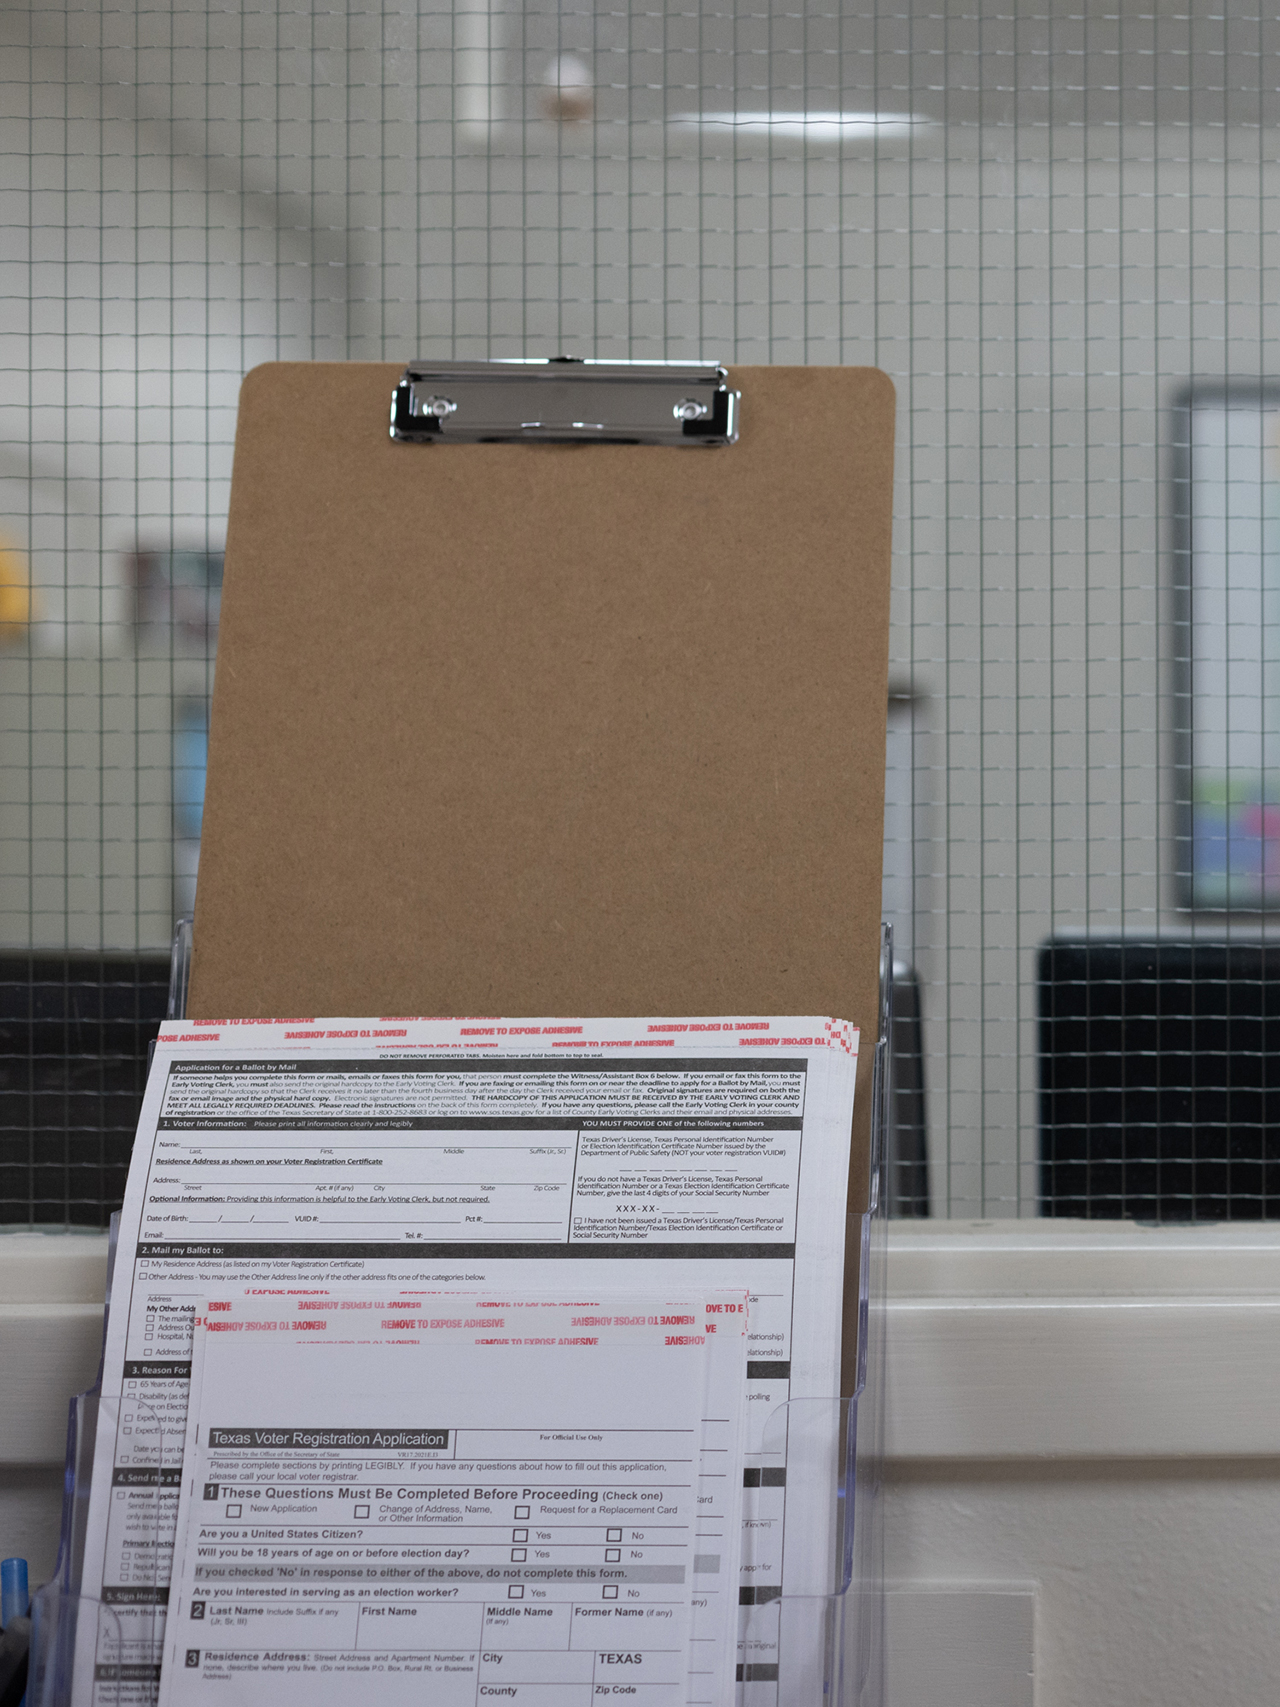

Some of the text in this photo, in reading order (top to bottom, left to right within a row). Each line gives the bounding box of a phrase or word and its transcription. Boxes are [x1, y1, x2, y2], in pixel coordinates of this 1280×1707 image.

[459, 1026, 583, 1036] REMOVE TO EXPOSE ADHESIVE
[174, 1064, 220, 1072] Application
[266, 1064, 277, 1072] by
[196, 1119, 247, 1127] Information:
[277, 1120, 296, 1128] print
[349, 1120, 374, 1128] clearly
[389, 1120, 413, 1128] legibly
[697, 1120, 731, 1128] following
[141, 1246, 150, 1254] 2.
[151, 1246, 170, 1254] Mail
[171, 1247, 185, 1255] my
[186, 1246, 210, 1254] Ballot
[381, 1318, 504, 1329] REMOVE TO EXPOSE ADHESIVE
[212, 1431, 444, 1447] Texas Voter Registration Application
[207, 1485, 663, 1503] 1 These Questions Must Be Completed Before Proceeding (Check one)
[197, 1547, 216, 1556] Will
[218, 1549, 238, 1559] you
[240, 1547, 254, 1557] be
[257, 1547, 268, 1557] 18
[270, 1550, 299, 1559] years
[301, 1548, 313, 1557] of
[314, 1550, 333, 1559] age
[365, 1548, 398, 1557] before
[400, 1548, 441, 1558] election
[444, 1548, 470, 1560] day?
[534, 1549, 550, 1558] Yes
[630, 1550, 643, 1558] No
[193, 1604, 264, 1618] 2 Last Name
[361, 1606, 417, 1616] First Name
[486, 1607, 553, 1616] Middle Name
[574, 1607, 644, 1616] Former Name
[187, 1652, 309, 1667] 3 Residence Address:
[482, 1652, 503, 1664] City
[599, 1653, 642, 1664] TEXAS
[479, 1685, 517, 1697] County
[594, 1685, 637, 1695] Zip Code
